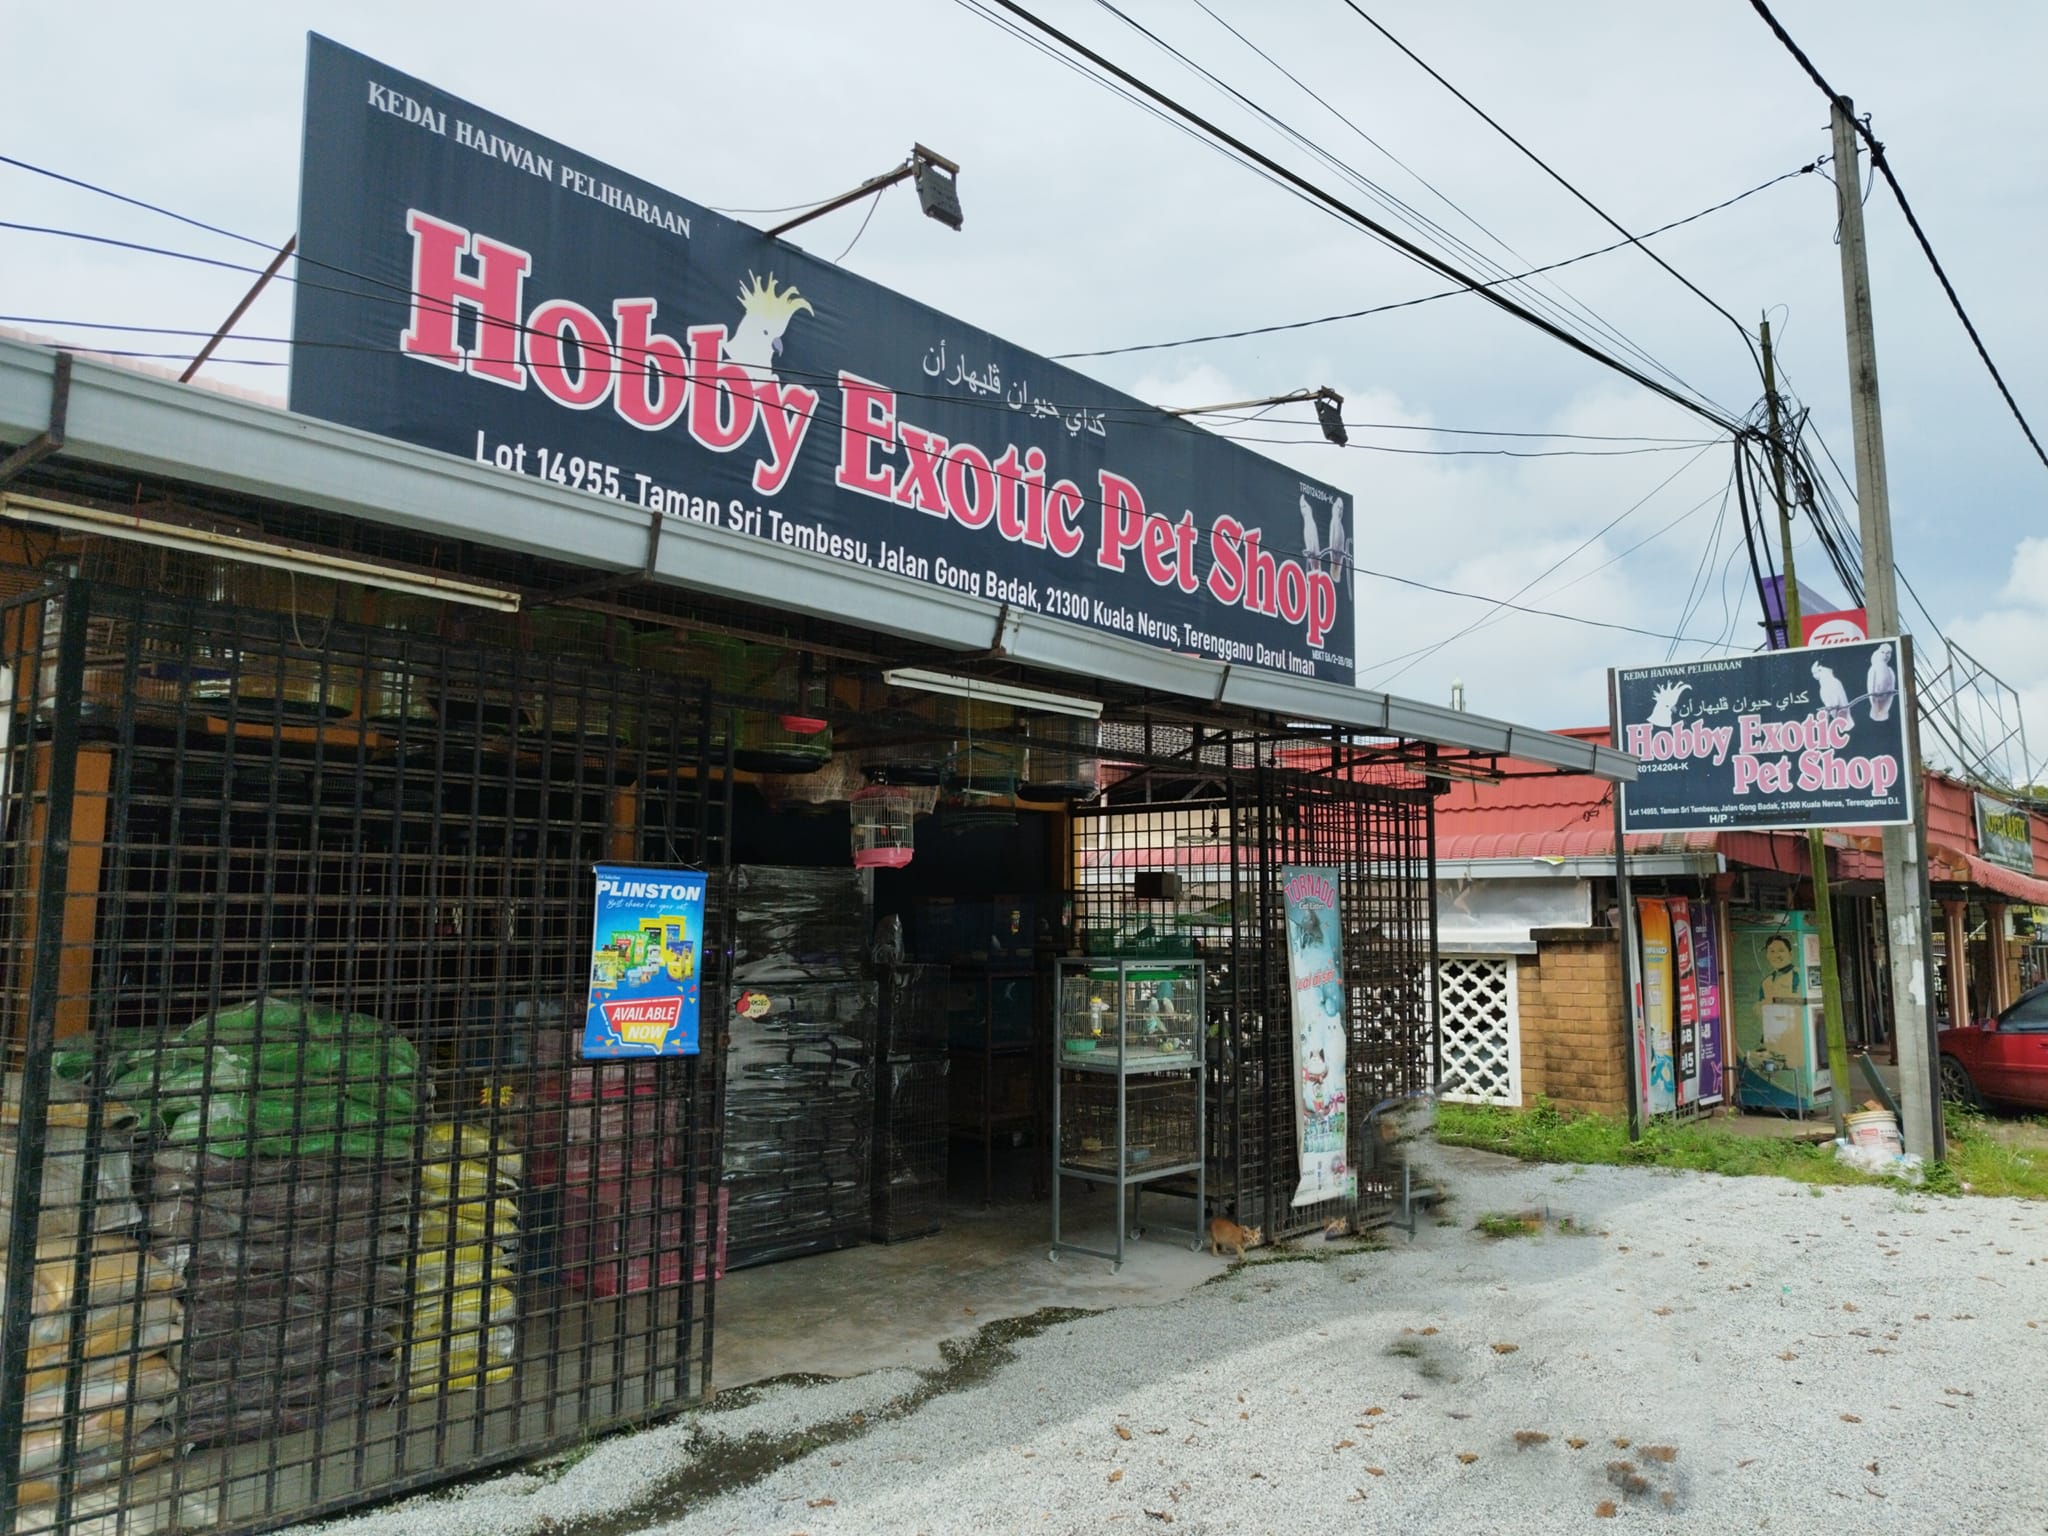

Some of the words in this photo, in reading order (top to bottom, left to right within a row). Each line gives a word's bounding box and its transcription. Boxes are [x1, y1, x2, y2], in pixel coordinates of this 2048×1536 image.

[368, 80, 447, 136] KEDAI
[455, 119, 553, 182] HAIWAN
[560, 164, 691, 240] PELIHARAAN
[401, 208, 819, 495] Hobby
[836, 369, 1085, 558] Exotic
[1098, 468, 1199, 594] Pet
[1207, 513, 1336, 648] Shop
[475, 429, 527, 474] Lot
[635, 472, 721, 526] Taman
[727, 499, 762, 537] Sri
[768, 509, 873, 568] Tembesu,
[878, 540, 929, 581] Jalan
[934, 556, 980, 597] Gong
[985, 570, 1041, 614] Badak,
[1046, 586, 1090, 621] 21300
[1093, 599, 1134, 632] Kuala
[1138, 612, 1180, 647] Nerus,
[1183, 623, 1254, 662] Terengganu
[1256, 643, 1286, 669] Darul
[1288, 651, 1315, 677] Iman
[1623, 670, 1649, 681] KEDAI
[1650, 667, 1686, 678] HAIWAN
[1687, 660, 1743, 674] PELIHARAAN
[1626, 718, 1734, 767] Hobby
[1738, 708, 1850, 755] Exotic
[1732, 753, 1793, 795] Pet
[1797, 749, 1899, 797] Shop
[1629, 808, 1640, 816] Lot
[1660, 806, 1680, 815] Taman
[1680, 805, 1690, 814] Sri
[1720, 804, 1738, 812] Jalan
[1738, 803, 1757, 813] Gong
[1781, 801, 1801, 810] 21300
[1801, 800, 1821, 809] Kuala
[1822, 800, 1845, 808] Nerus,
[1845, 798, 1887, 808] Terengganu
[1709, 814, 1728, 824] H/P
[597, 880, 701, 902] PLINSTON
[1283, 873, 1336, 909] TORNADO
[611, 1006, 677, 1021] AVAILABLE
[627, 1025, 665, 1040] NOW
